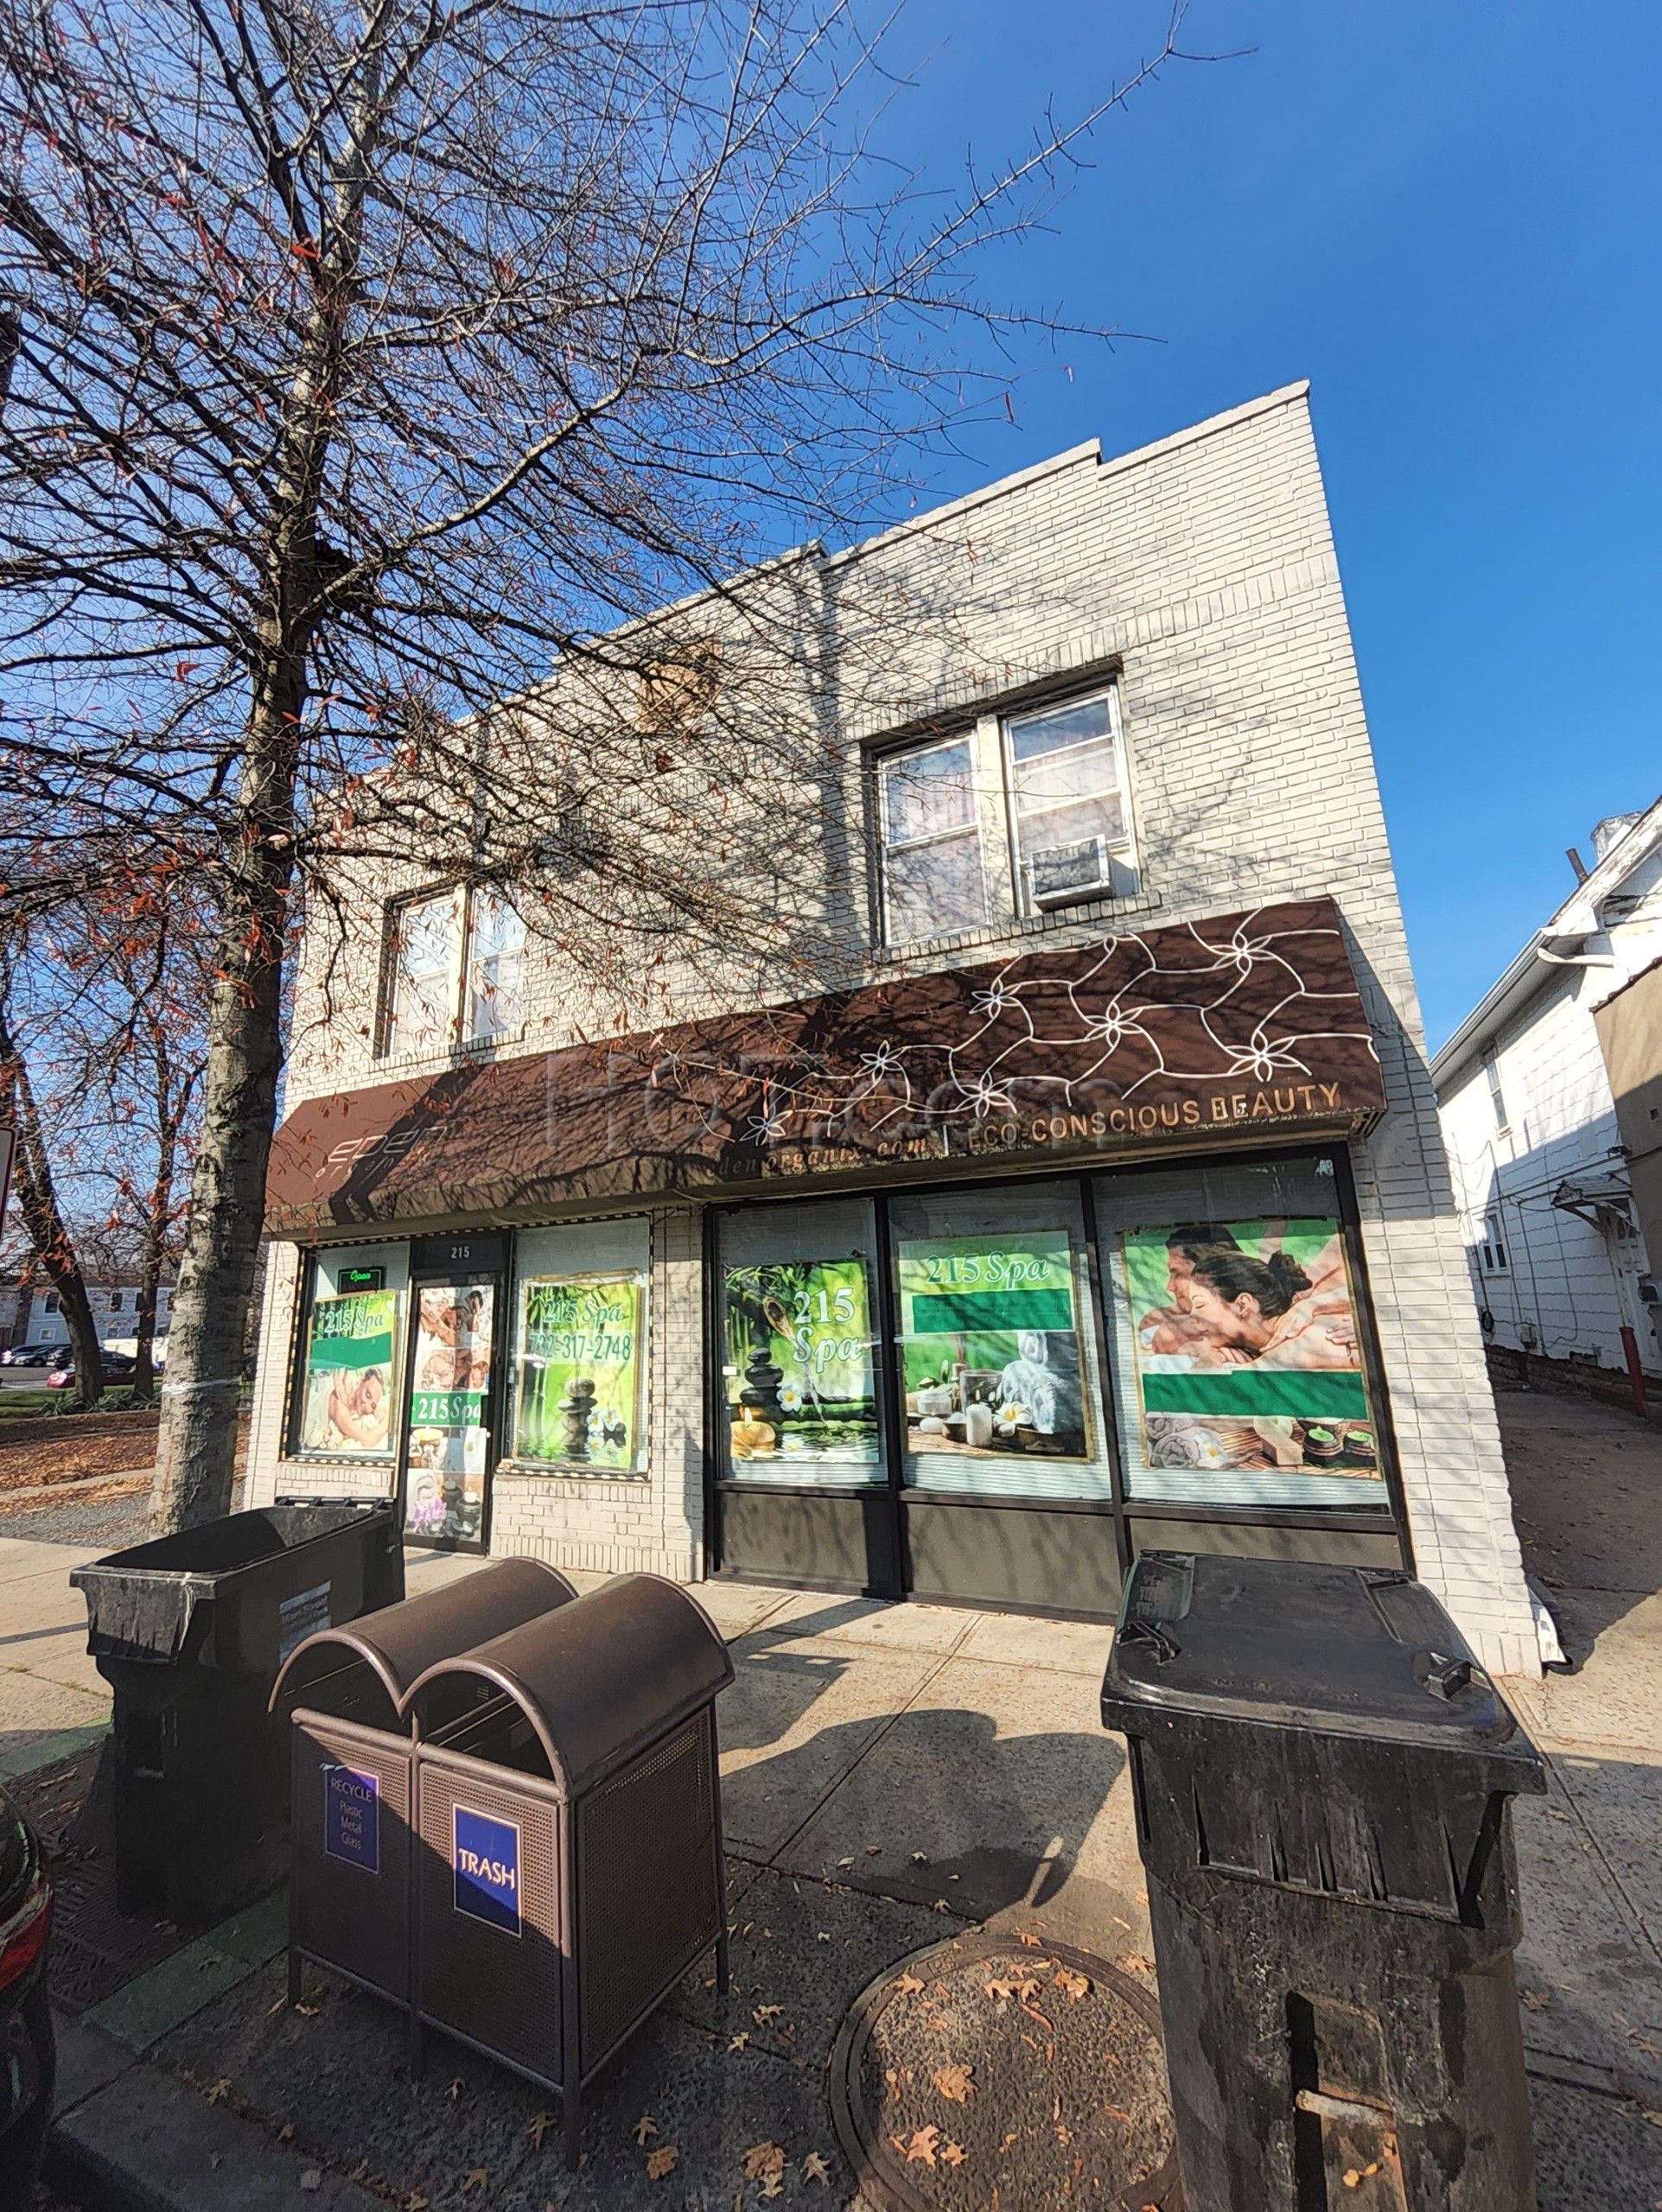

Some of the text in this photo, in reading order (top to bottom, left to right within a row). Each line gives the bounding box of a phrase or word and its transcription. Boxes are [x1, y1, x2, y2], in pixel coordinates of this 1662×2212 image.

[1211, 1082, 1339, 1121] BEAUTY
[450, 1246, 471, 1259] 215
[927, 1250, 1051, 1291] 215 Spa
[323, 1306, 385, 1335] 215 Spa
[544, 1298, 624, 1329] 215 Spa
[793, 1287, 855, 1324] 215
[793, 1326, 863, 1374] Spa
[417, 1397, 449, 1420] 215
[330, 1776, 373, 1803] RECYCLE
[458, 1847, 515, 1891] TRASH
